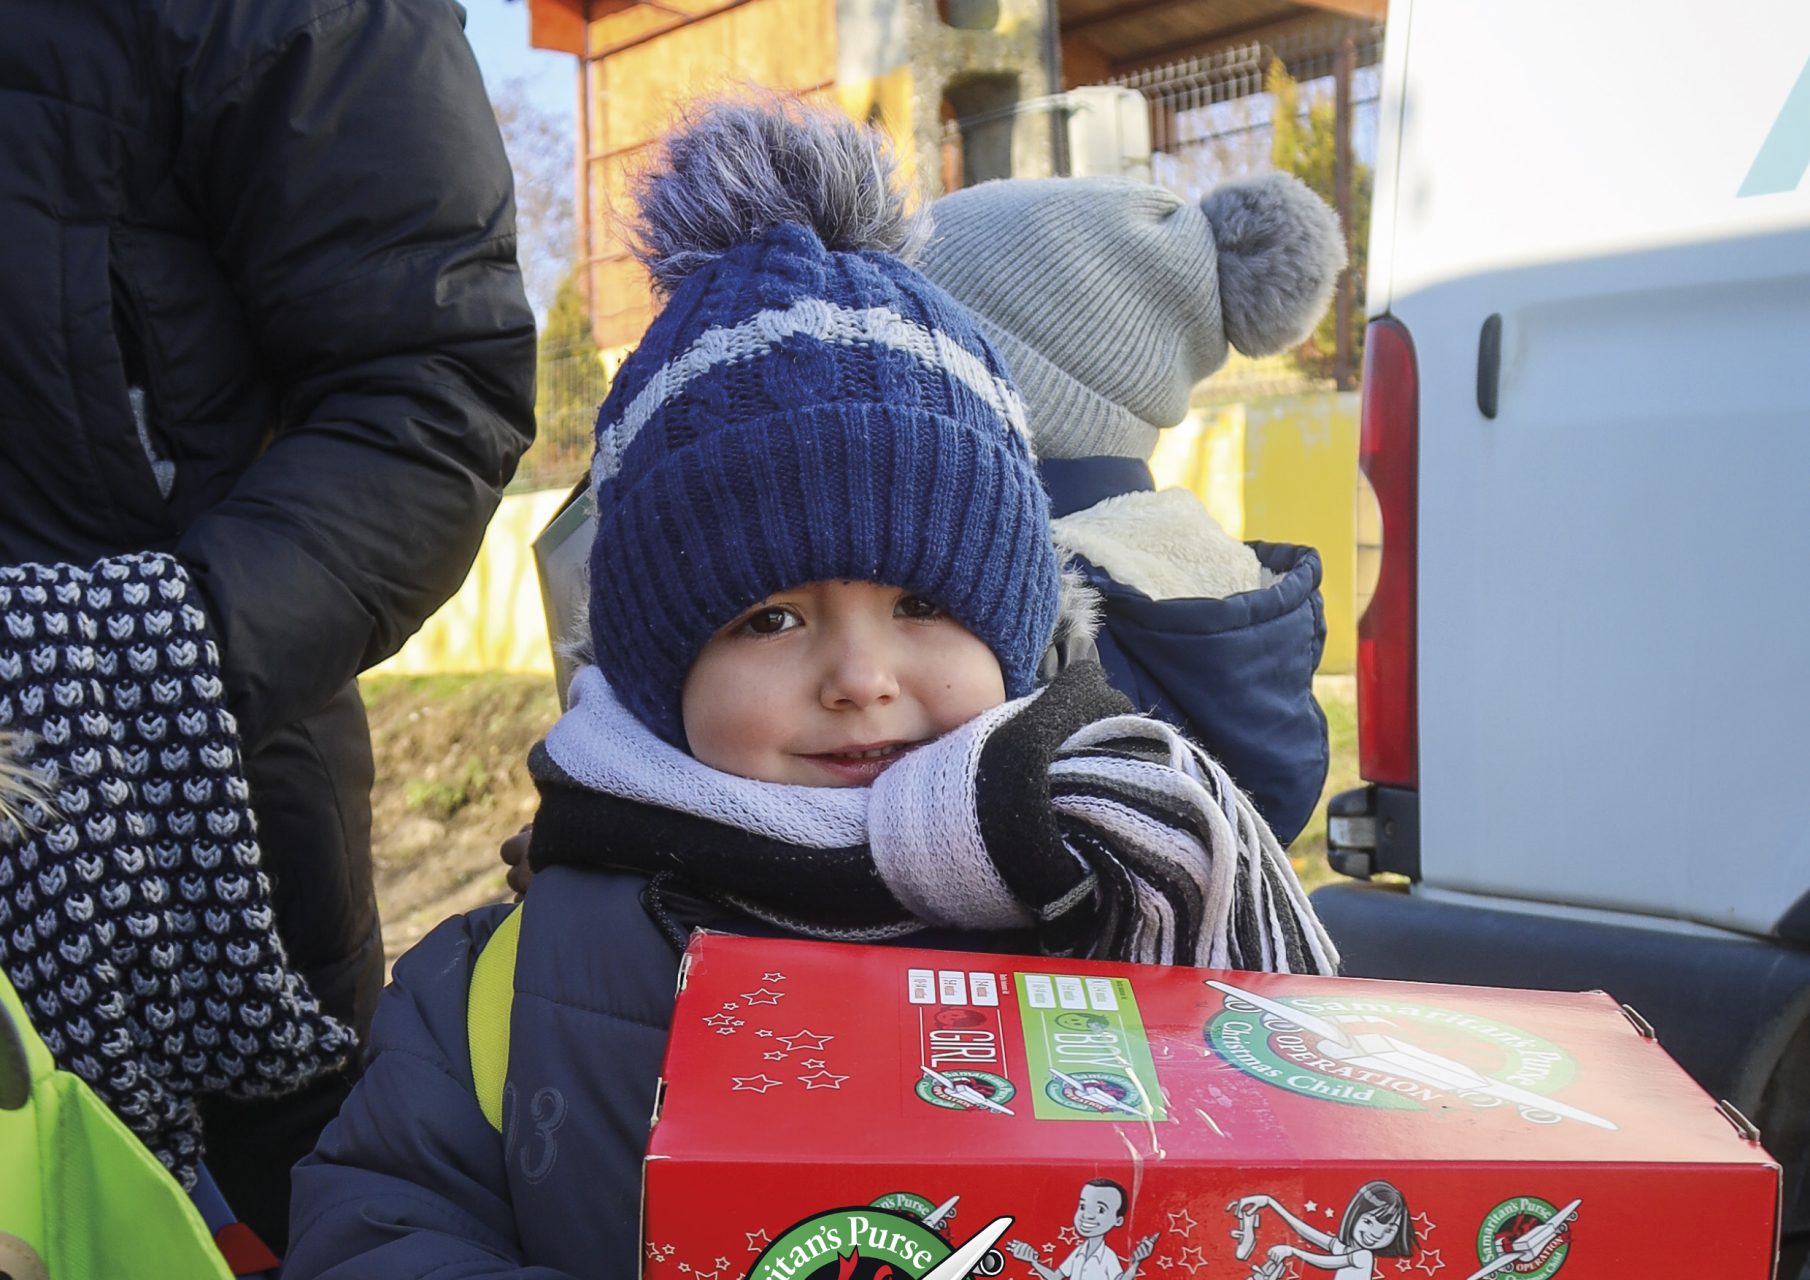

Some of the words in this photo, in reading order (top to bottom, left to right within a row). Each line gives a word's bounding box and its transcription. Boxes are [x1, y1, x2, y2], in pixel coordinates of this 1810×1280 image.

[928, 1029, 997, 1068] GIRL
[1053, 1031, 1128, 1069] BOY
[1220, 1020, 1284, 1078] Christmas
[1286, 1074, 1376, 1101] Child
[1275, 1034, 1445, 1101] OPERATION
[896, 1193, 931, 1216] Purse
[1482, 1201, 1520, 1263] Samaritan's
[1520, 1197, 1553, 1220] Purse
[1515, 1235, 1564, 1272] OPERATION
